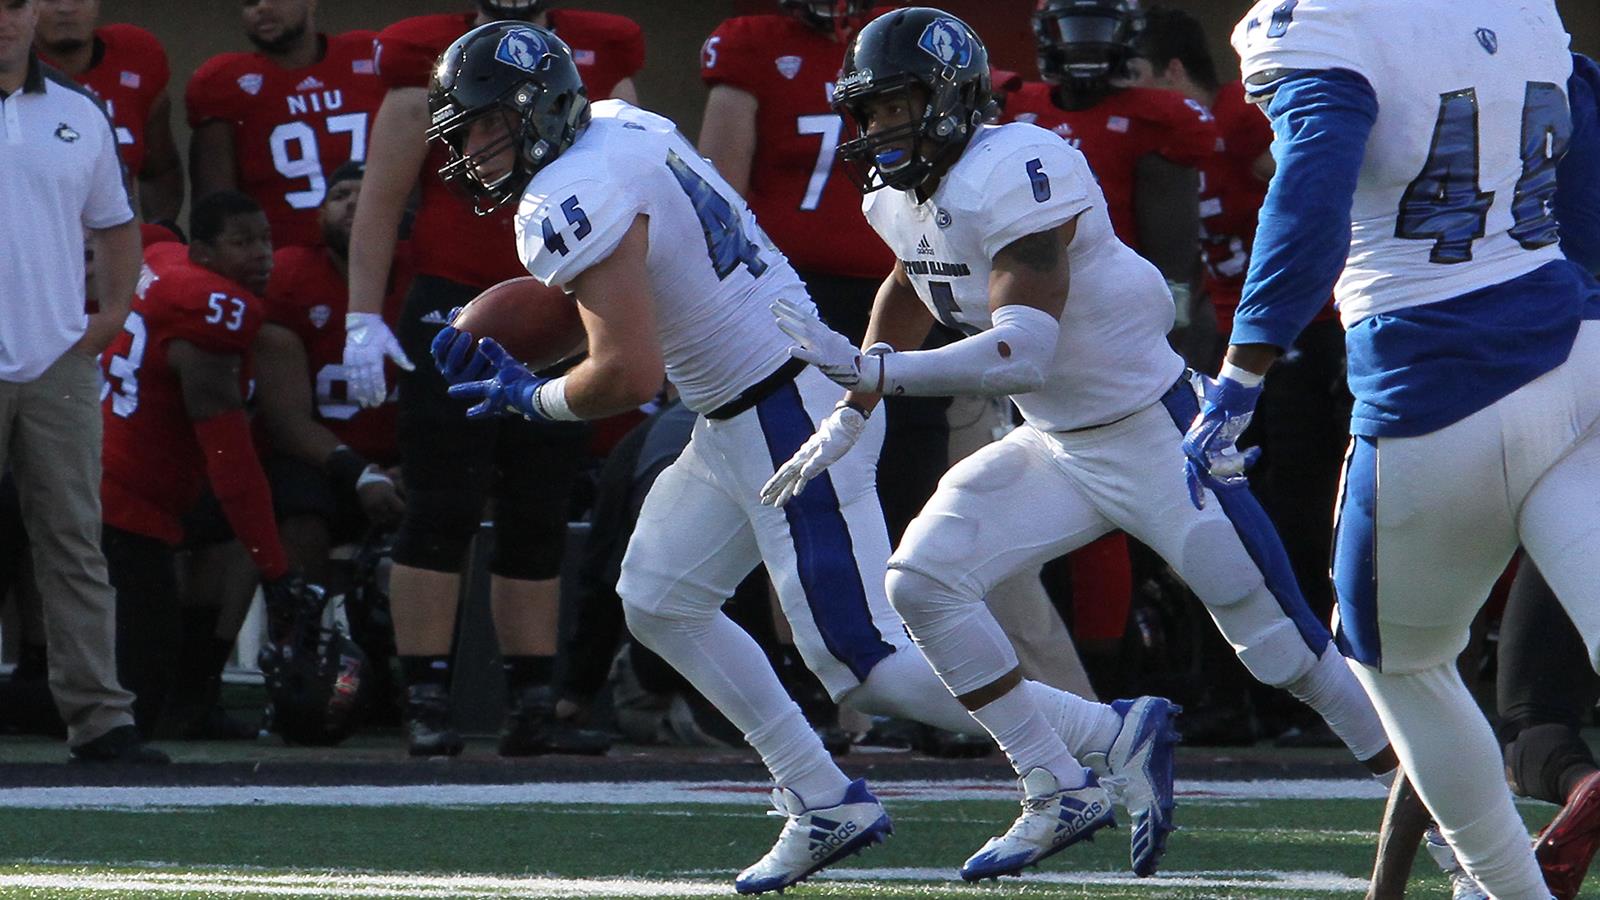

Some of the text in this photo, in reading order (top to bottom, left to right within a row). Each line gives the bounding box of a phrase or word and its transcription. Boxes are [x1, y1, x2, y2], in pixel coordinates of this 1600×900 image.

[702, 36, 720, 68] 5
[286, 89, 343, 115] NIU
[270, 112, 369, 208] 97
[1025, 158, 1051, 203] 6
[541, 195, 592, 257] 45
[666, 147, 781, 282] 4
[205, 292, 246, 331] 53
[96, 311, 147, 419] 3
[811, 820, 858, 862] adidas
